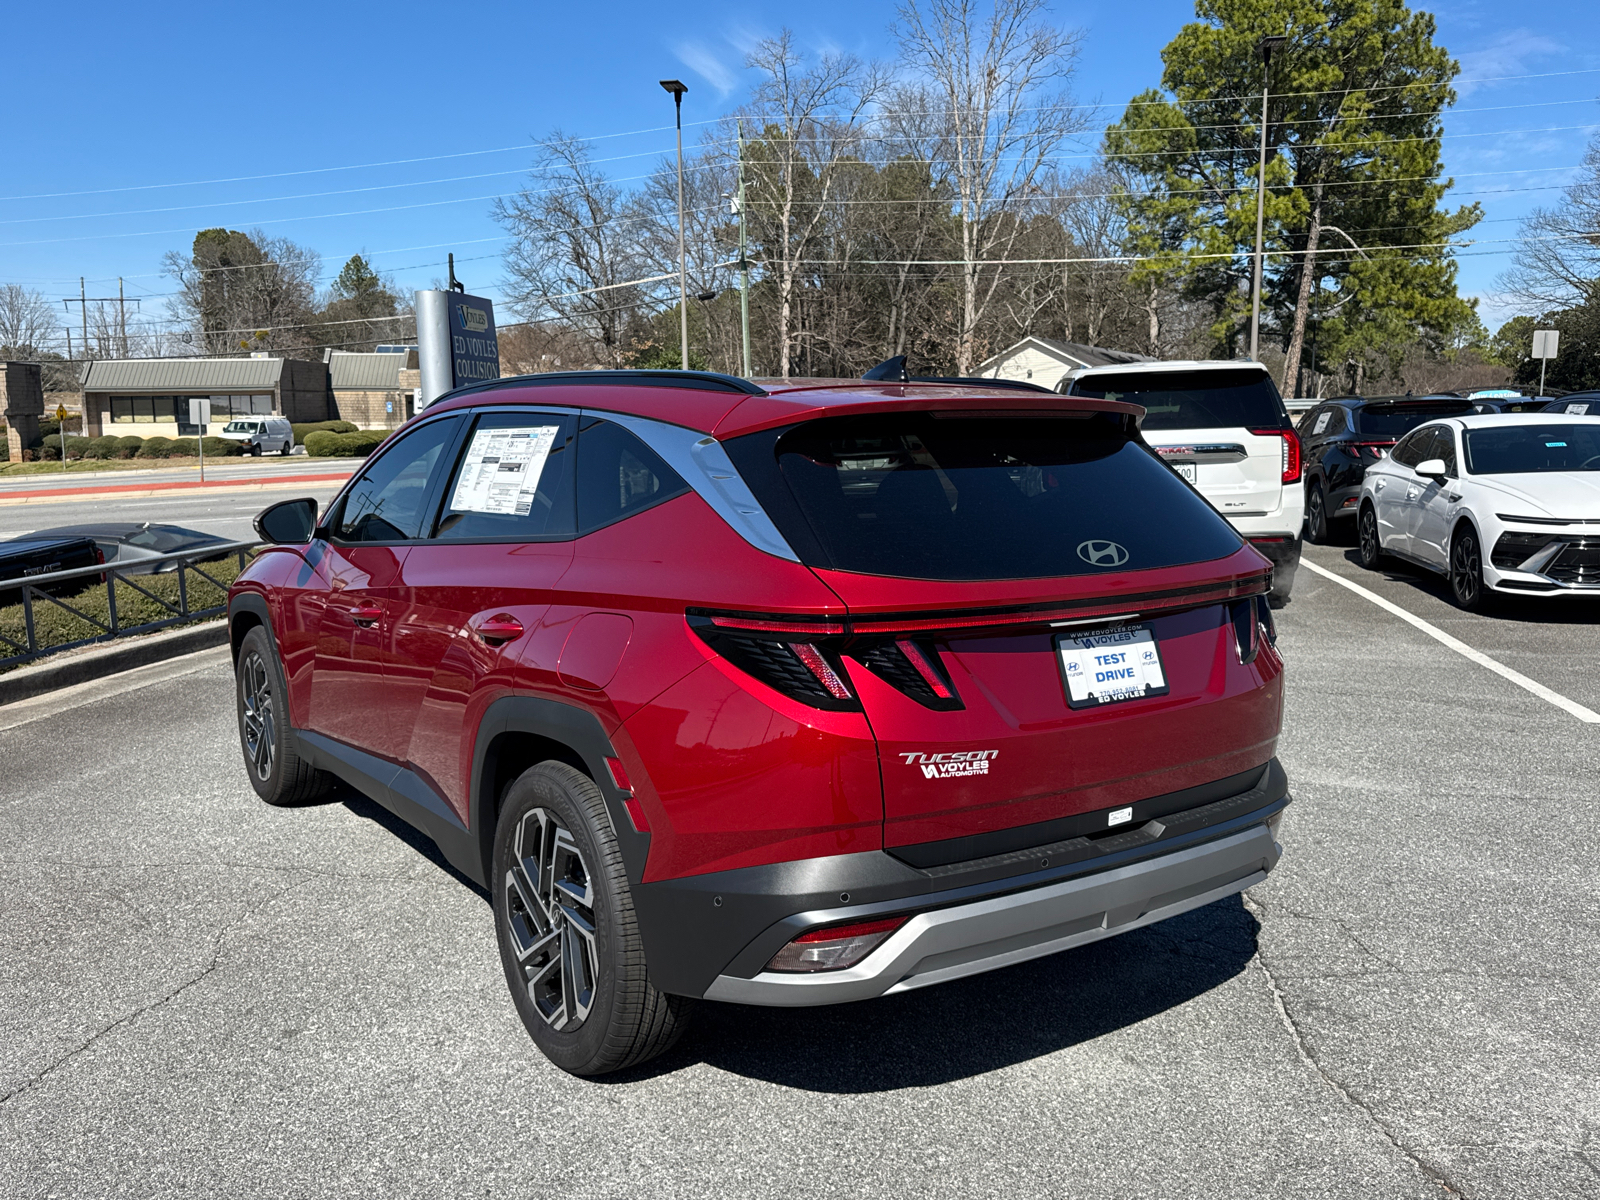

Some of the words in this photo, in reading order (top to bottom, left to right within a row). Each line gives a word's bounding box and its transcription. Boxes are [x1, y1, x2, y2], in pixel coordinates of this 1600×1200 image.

[460, 305, 486, 327] VOYLES
[454, 336, 466, 354] ED
[467, 338, 497, 358] VOYLES
[456, 359, 498, 380] COLLISION
[1070, 625, 1143, 638] WWW.EDVOYLES.COM
[1093, 633, 1132, 645] VOYLES
[1094, 652, 1127, 667] TEST
[1095, 667, 1136, 683] DRIVE
[1098, 695, 1111, 704] ED
[1111, 690, 1146, 701] VOYLES
[899, 749, 999, 765] TUCSON
[939, 760, 989, 772] VOYLES
[940, 769, 989, 778] AUTOMOTIVE
